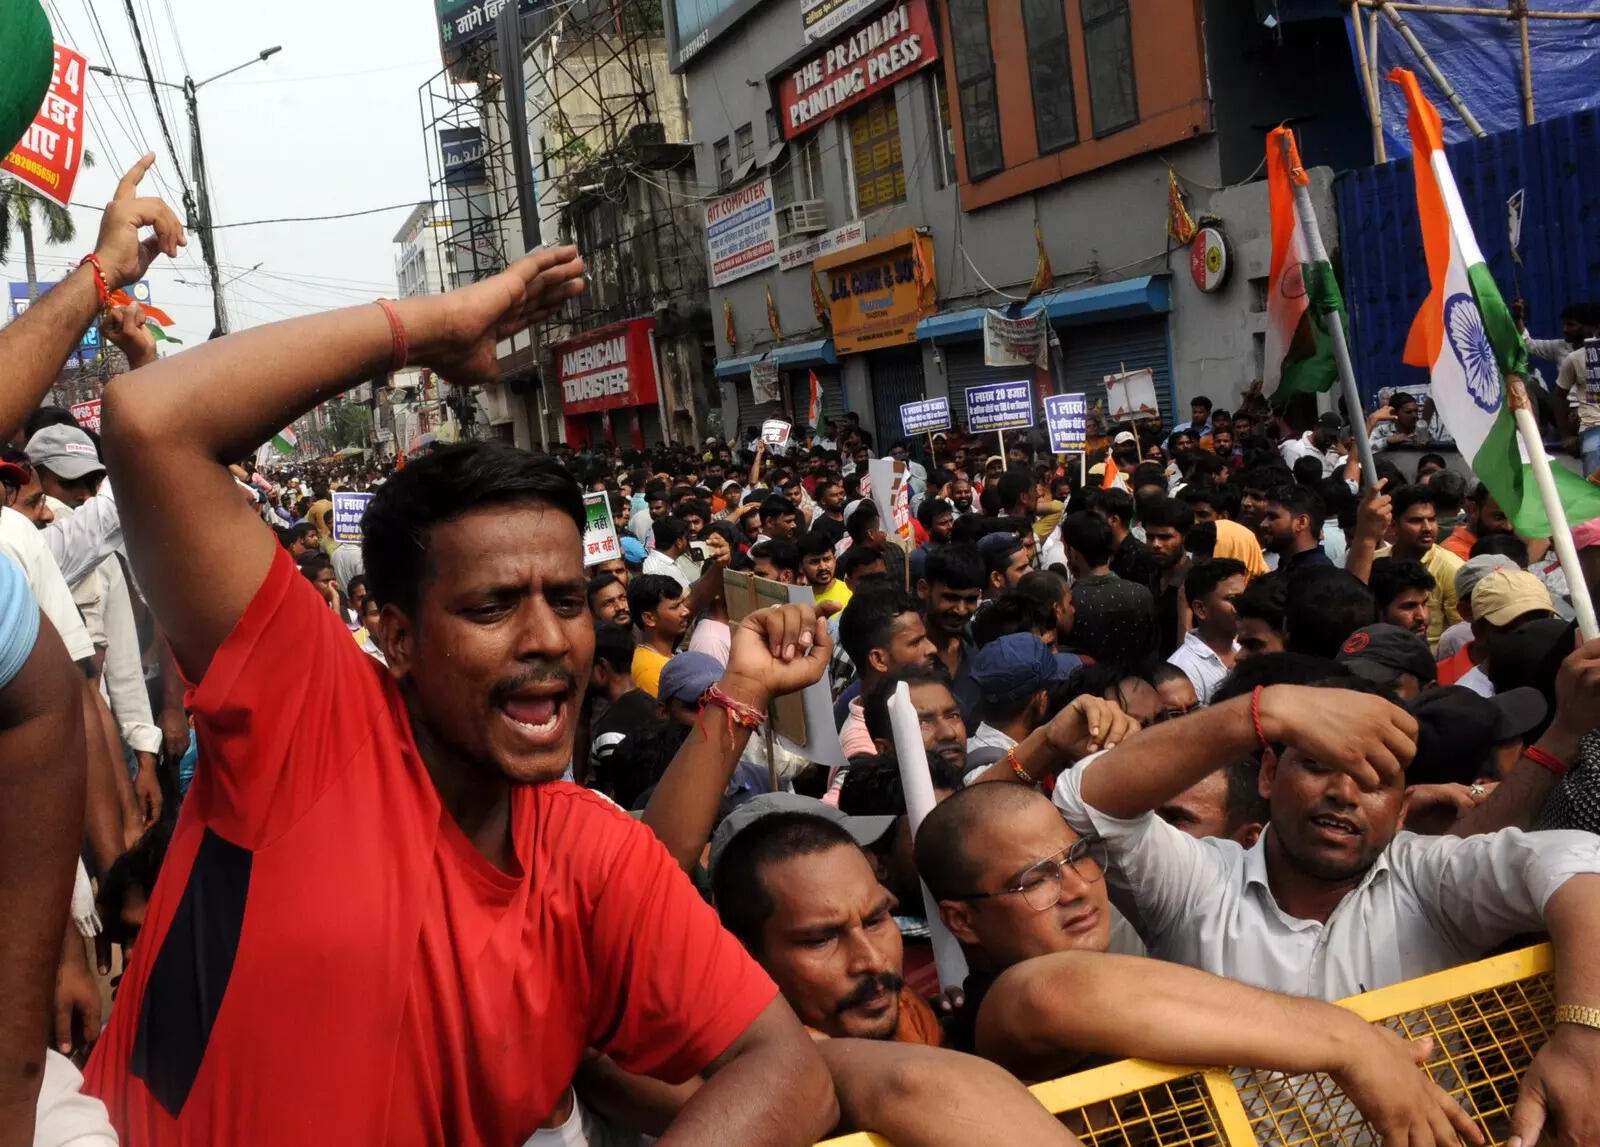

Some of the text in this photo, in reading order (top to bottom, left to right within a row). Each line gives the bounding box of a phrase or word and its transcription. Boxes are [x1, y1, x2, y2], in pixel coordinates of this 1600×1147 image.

[456, 5, 482, 34] मांगे
[792, 60, 824, 94] THE
[826, 6, 909, 73] PRATILIPI
[65, 59, 79, 96] 4
[790, 34, 921, 128] PRINTING PRESS
[721, 182, 766, 215] COMPUTER
[562, 336, 626, 377] AMERICAN
[562, 366, 629, 403] TOURISTER
[969, 393, 974, 404] 1
[995, 388, 1006, 400] 20
[1049, 401, 1083, 415] 1 लाख
[337, 497, 343, 510] 1
[592, 513, 608, 530] नहीं
[587, 536, 615, 555] कम नहीं
